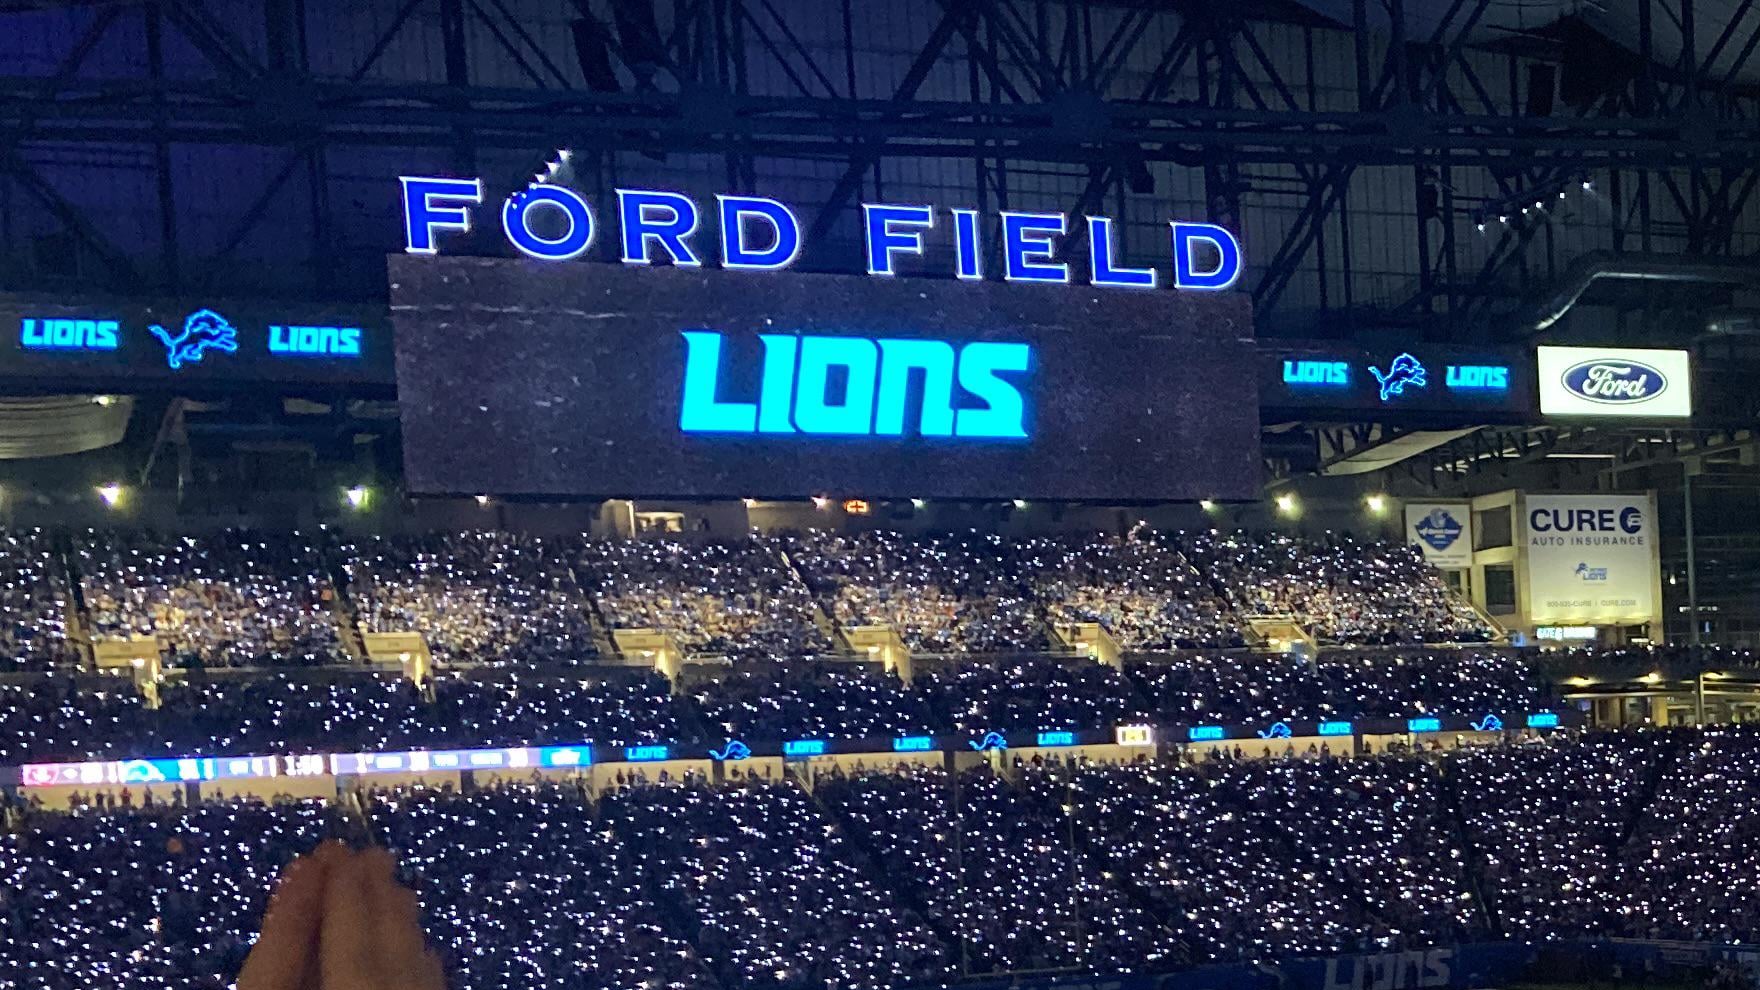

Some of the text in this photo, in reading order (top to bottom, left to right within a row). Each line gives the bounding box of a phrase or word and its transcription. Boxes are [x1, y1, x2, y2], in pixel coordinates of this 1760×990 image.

[399, 175, 1242, 290] FORD FIELD
[22, 319, 119, 348] LIONS
[269, 326, 362, 354] LIONS
[680, 329, 1033, 439] LIONS
[1284, 361, 1349, 385] LIONS
[1446, 366, 1508, 389] LIONS
[1582, 366, 1646, 398] Ford
[1530, 508, 1615, 532] CURE
[1532, 536, 1644, 547] AUTO INSURANCE
